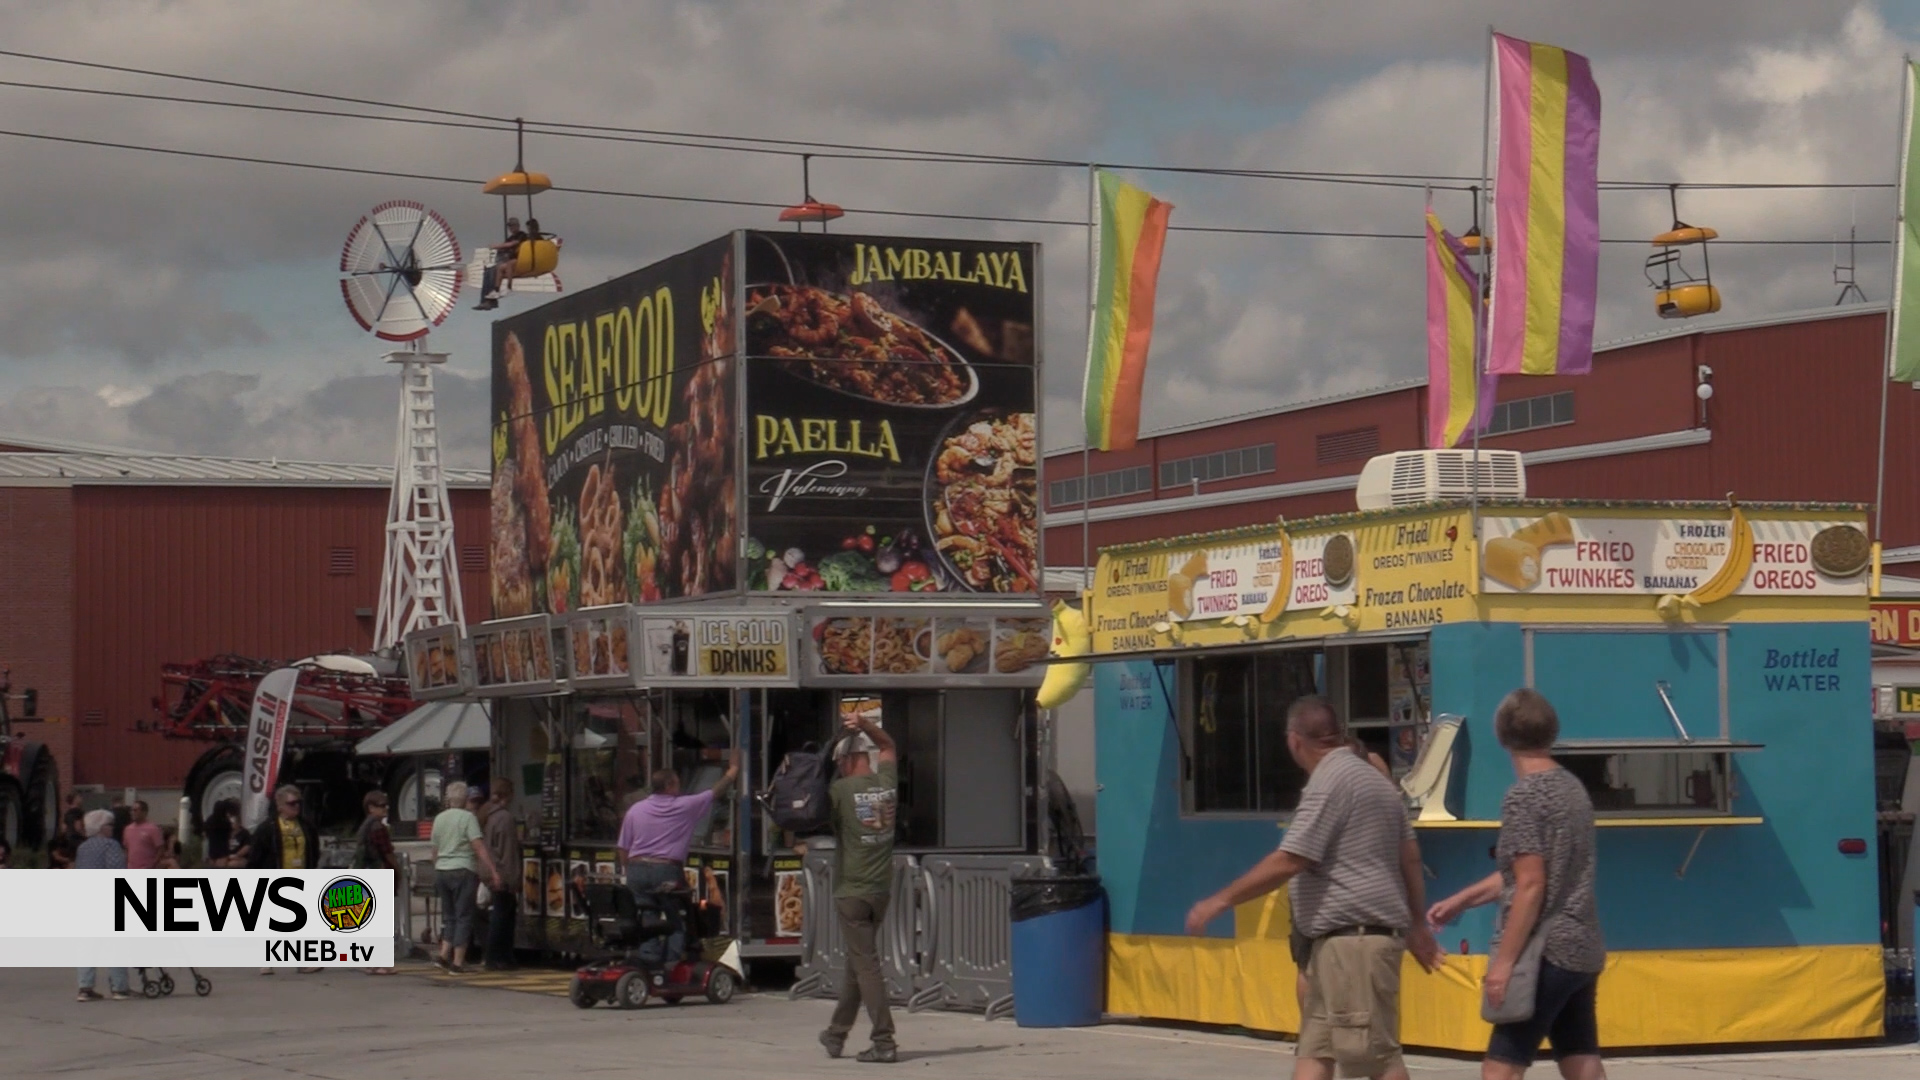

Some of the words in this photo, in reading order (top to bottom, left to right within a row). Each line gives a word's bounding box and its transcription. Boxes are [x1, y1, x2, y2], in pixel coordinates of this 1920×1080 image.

[851, 243, 1028, 293] JAMBALAYA
[544, 286, 674, 456] SEAFOOD
[756, 414, 901, 463] PAELLA
[1397, 523, 1428, 546] Fried
[1680, 525, 1725, 538] FROZEN
[1373, 548, 1453, 569] OREOS/TWINKIES
[1577, 541, 1635, 562] FRIED
[1674, 542, 1726, 556] CHOCOLATE
[1753, 543, 1808, 563] FRIED
[1124, 558, 1149, 577] Fried
[1295, 557, 1324, 579] FRIED
[1665, 556, 1708, 570] COVERED
[1210, 568, 1238, 589] FRIED
[1546, 569, 1635, 588] TWINKIES
[1644, 576, 1698, 589] BANANAS
[1753, 570, 1817, 590] OREOS
[1107, 581, 1168, 598] OREOS/TWINKIES
[1295, 583, 1329, 604] OREOS
[1365, 588, 1404, 607] Frozen
[1408, 580, 1465, 603] Chocolate
[1197, 593, 1238, 614] TWINKIES
[1097, 614, 1127, 632] Frozen
[1129, 609, 1169, 630] Chocolat
[1386, 607, 1443, 628] BANANAS
[1870, 609, 1899, 640] RN
[701, 620, 731, 645] ICE
[735, 619, 784, 645] COLD
[1113, 633, 1156, 651] BANANAS
[710, 648, 777, 675] DRINKS
[1764, 648, 1840, 669] Bottled
[1765, 675, 1841, 692] WATER
[249, 717, 273, 794] CASE
